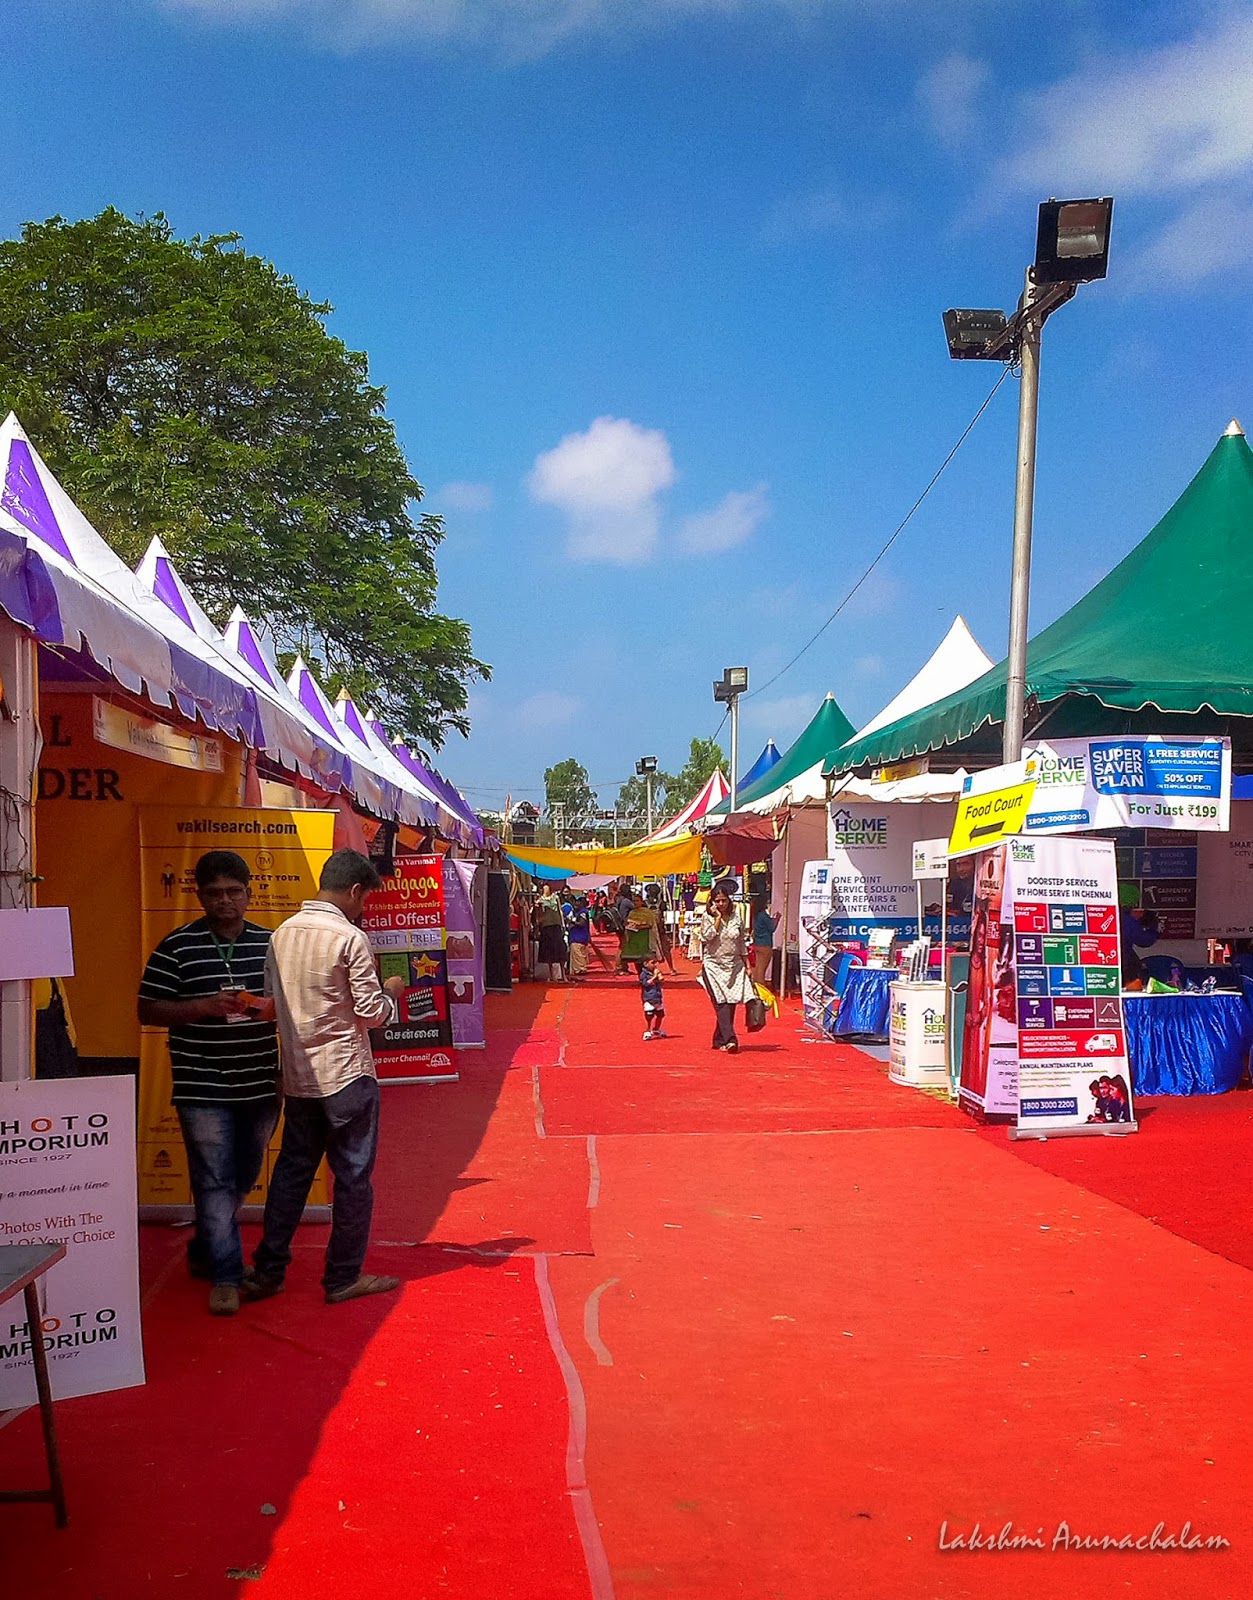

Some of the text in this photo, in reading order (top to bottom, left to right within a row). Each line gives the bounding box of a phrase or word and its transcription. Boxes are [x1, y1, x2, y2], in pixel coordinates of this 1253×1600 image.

[50, 715, 71, 747] L
[1092, 747, 1143, 763] SUPER
[1156, 749, 1180, 758] FREE
[1180, 749, 1219, 759] SERVICE
[1094, 761, 1144, 776] SAVER
[38, 768, 124, 801] DER
[1096, 774, 1144, 789] PLAN
[1164, 773, 1204, 783] 50% OFF
[965, 794, 1023, 820] Food Court
[1129, 803, 1151, 815] For
[1154, 803, 1184, 816] Just
[176, 820, 298, 835] vakilsearch.com
[835, 818, 887, 832] HOME
[835, 832, 887, 845] SERVE
[834, 876, 852, 884] ONE
[854, 876, 882, 884] POINT
[1027, 877, 1099, 887] DOORSTEP SERVICES
[834, 885, 915, 894] SERVICE SOLUTION
[1017, 888, 1026, 896] BY
[1027, 889, 1048, 897] HOME
[1048, 889, 1071, 898] SERVE
[1081, 890, 1112, 899] CHENNAI
[834, 895, 850, 903] FOR
[852, 895, 889, 903] REPAIRS
[890, 895, 897, 903] &
[834, 905, 898, 913] MAINTENANCE
[360, 911, 441, 928] ecial Offers!
[832, 925, 857, 936] Call
[383, 1055, 400, 1064] over
[1022, 1101, 1040, 1110] 1800
[1040, 1101, 1057, 1109] 3000
[1057, 1100, 1075, 1108] 2200
[0, 1113, 109, 1136] HOTO
[0, 1131, 109, 1155] MPORIUM
[43, 1153, 72, 1162] 1927
[19, 1185, 67, 1197] moment
[69, 1184, 81, 1193] in
[84, 1180, 110, 1190] time
[44, 1214, 76, 1230] With
[79, 1212, 104, 1226] The
[72, 1229, 116, 1245] Choice
[9, 1308, 117, 1339] HOTO
[0, 1325, 118, 1360] MPORIUM
[3, 1350, 81, 1370] SINC 1927
